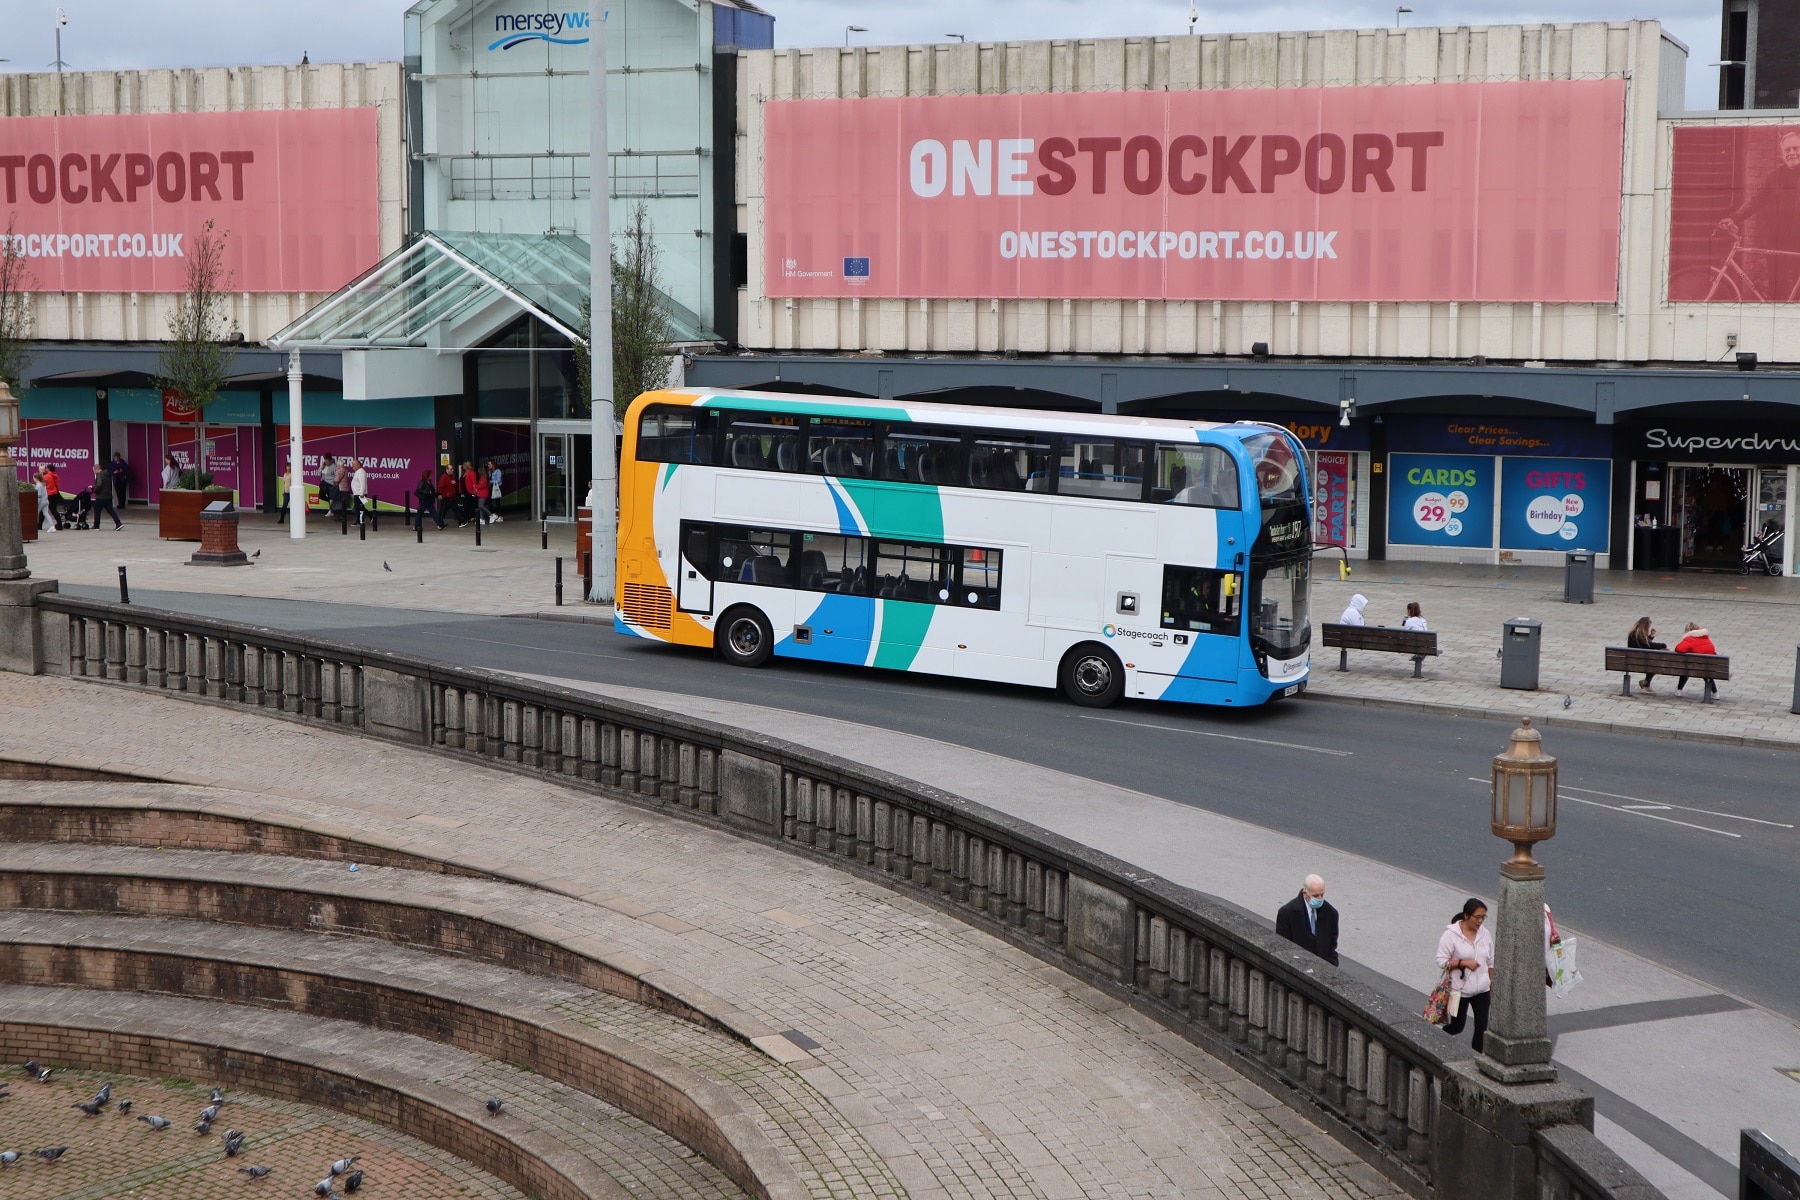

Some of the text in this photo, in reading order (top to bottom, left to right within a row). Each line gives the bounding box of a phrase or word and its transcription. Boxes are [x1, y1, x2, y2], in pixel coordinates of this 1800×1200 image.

[495, 11, 609, 35] merseyw
[909, 131, 1444, 198] ONESTOCKPORT
[0, 151, 254, 204] TOCKPORT
[1000, 230, 1338, 259] ONESTOCKPORT.CO.UK
[1447, 424, 1475, 433] Clear
[1468, 435, 1496, 445] Clear
[19, 447, 27, 457] IS
[31, 447, 52, 459] NOW
[53, 448, 89, 459] CLOSED
[1317, 455, 1346, 465] CHOICE!
[379, 458, 411, 469] AWAY
[1407, 467, 1477, 487] CARDS
[1526, 470, 1587, 491] GIFTS
[1331, 472, 1345, 542] PARTY
[1565, 505, 1580, 513] Baby
[1530, 510, 1563, 522] Birthday
[1292, 520, 1302, 539] 197
[1117, 627, 1169, 641] Stagecoach
